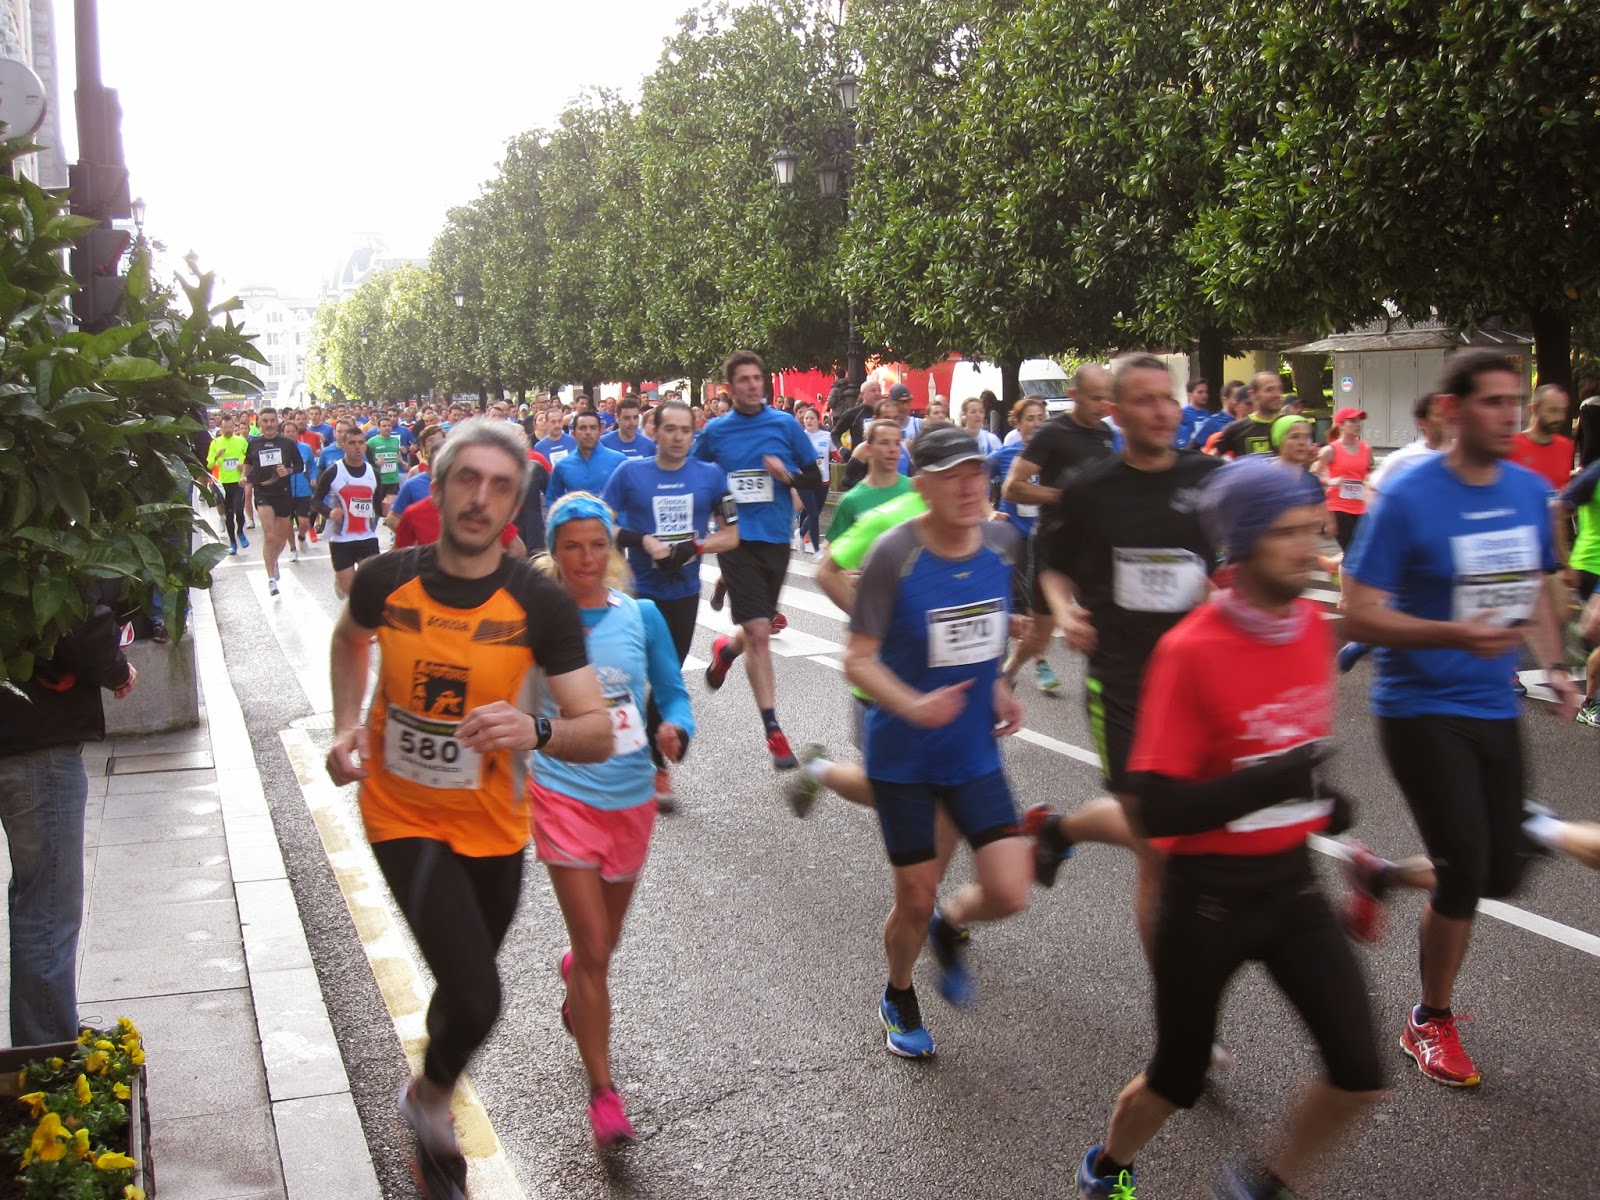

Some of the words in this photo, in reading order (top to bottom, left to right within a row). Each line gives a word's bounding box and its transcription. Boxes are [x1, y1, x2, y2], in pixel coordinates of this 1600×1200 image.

[736, 478, 765, 490] 296
[354, 503, 370, 511] 460
[660, 513, 687, 523] RUN
[400, 731, 460, 764] 580
